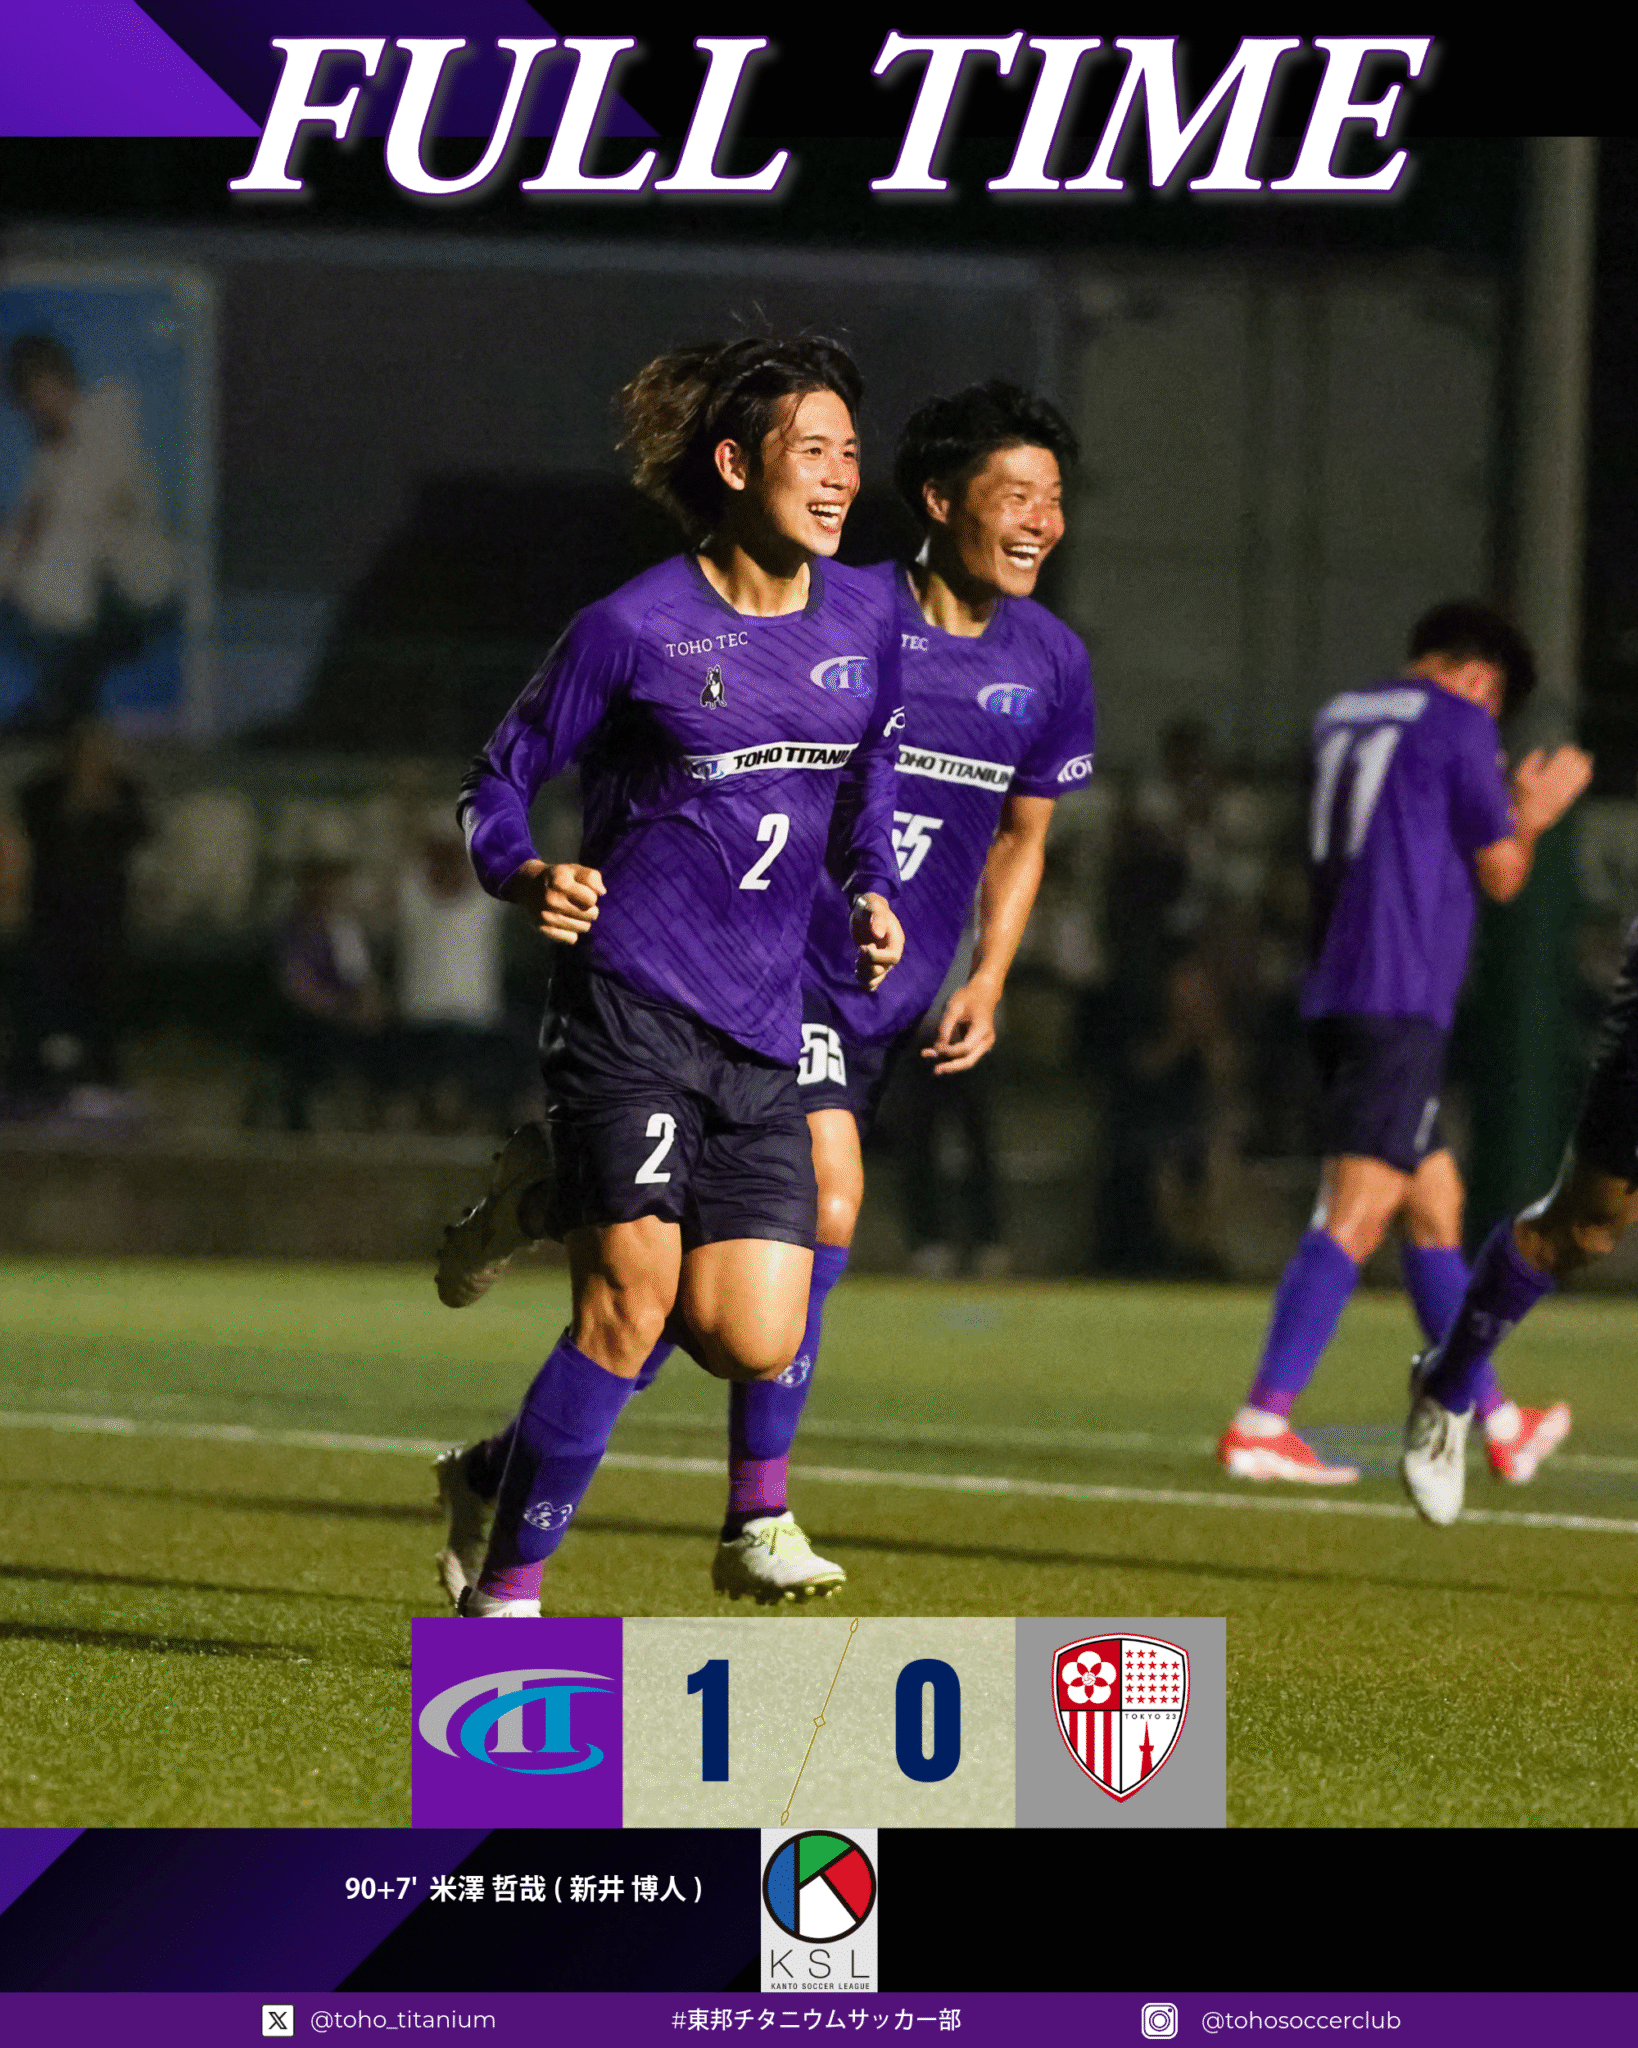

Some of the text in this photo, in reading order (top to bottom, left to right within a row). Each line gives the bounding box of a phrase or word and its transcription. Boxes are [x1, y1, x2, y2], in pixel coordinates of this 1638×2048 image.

[665, 631, 749, 658] TOHO TEC
[901, 633, 929, 652] TEC
[733, 747, 783, 770] TOHO
[899, 751, 936, 770] OHO
[1309, 726, 1401, 863] 11
[738, 812, 790, 891] 2
[634, 1112, 677, 1185] 2
